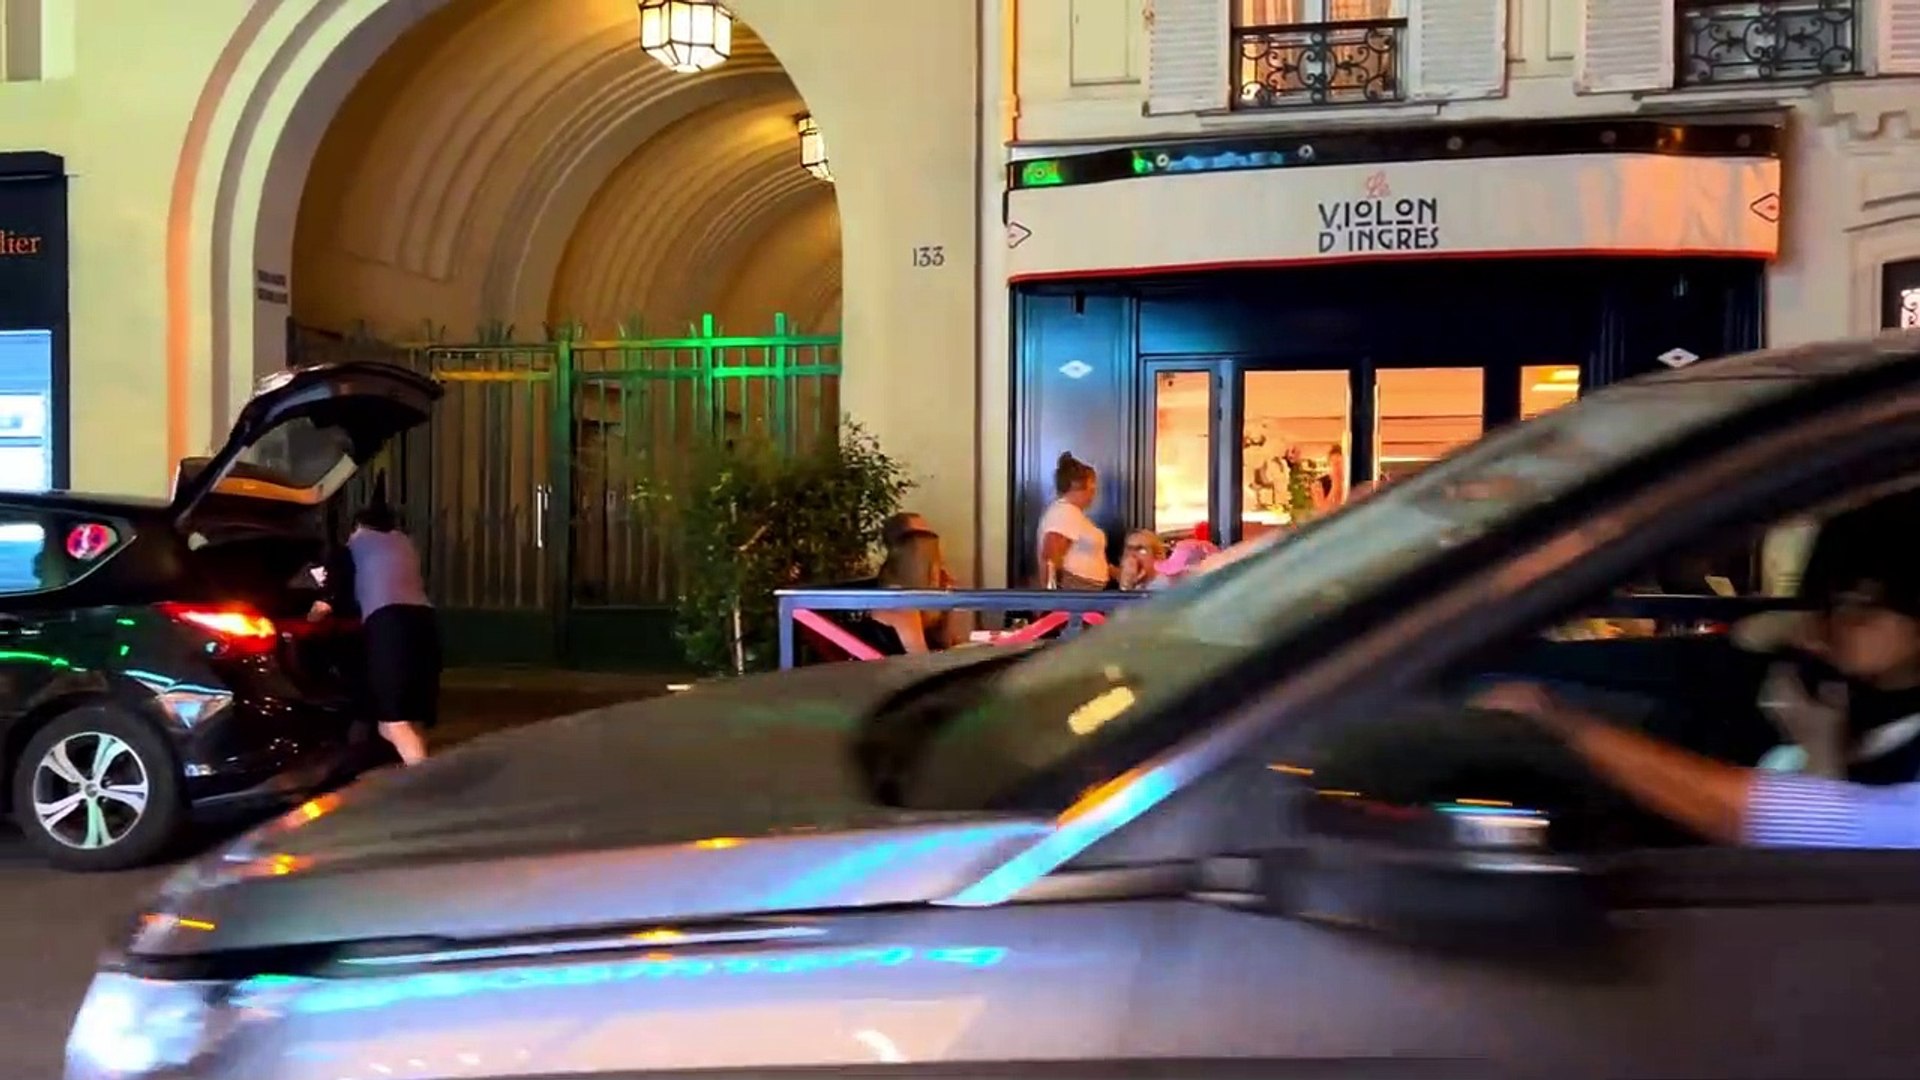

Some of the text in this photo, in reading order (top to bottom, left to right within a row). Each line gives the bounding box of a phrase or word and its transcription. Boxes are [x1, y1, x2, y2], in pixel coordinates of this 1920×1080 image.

[1318, 198, 1437, 228] VIOLON
[1319, 225, 1439, 253] D'INGRES
[912, 246, 945, 267] 133
